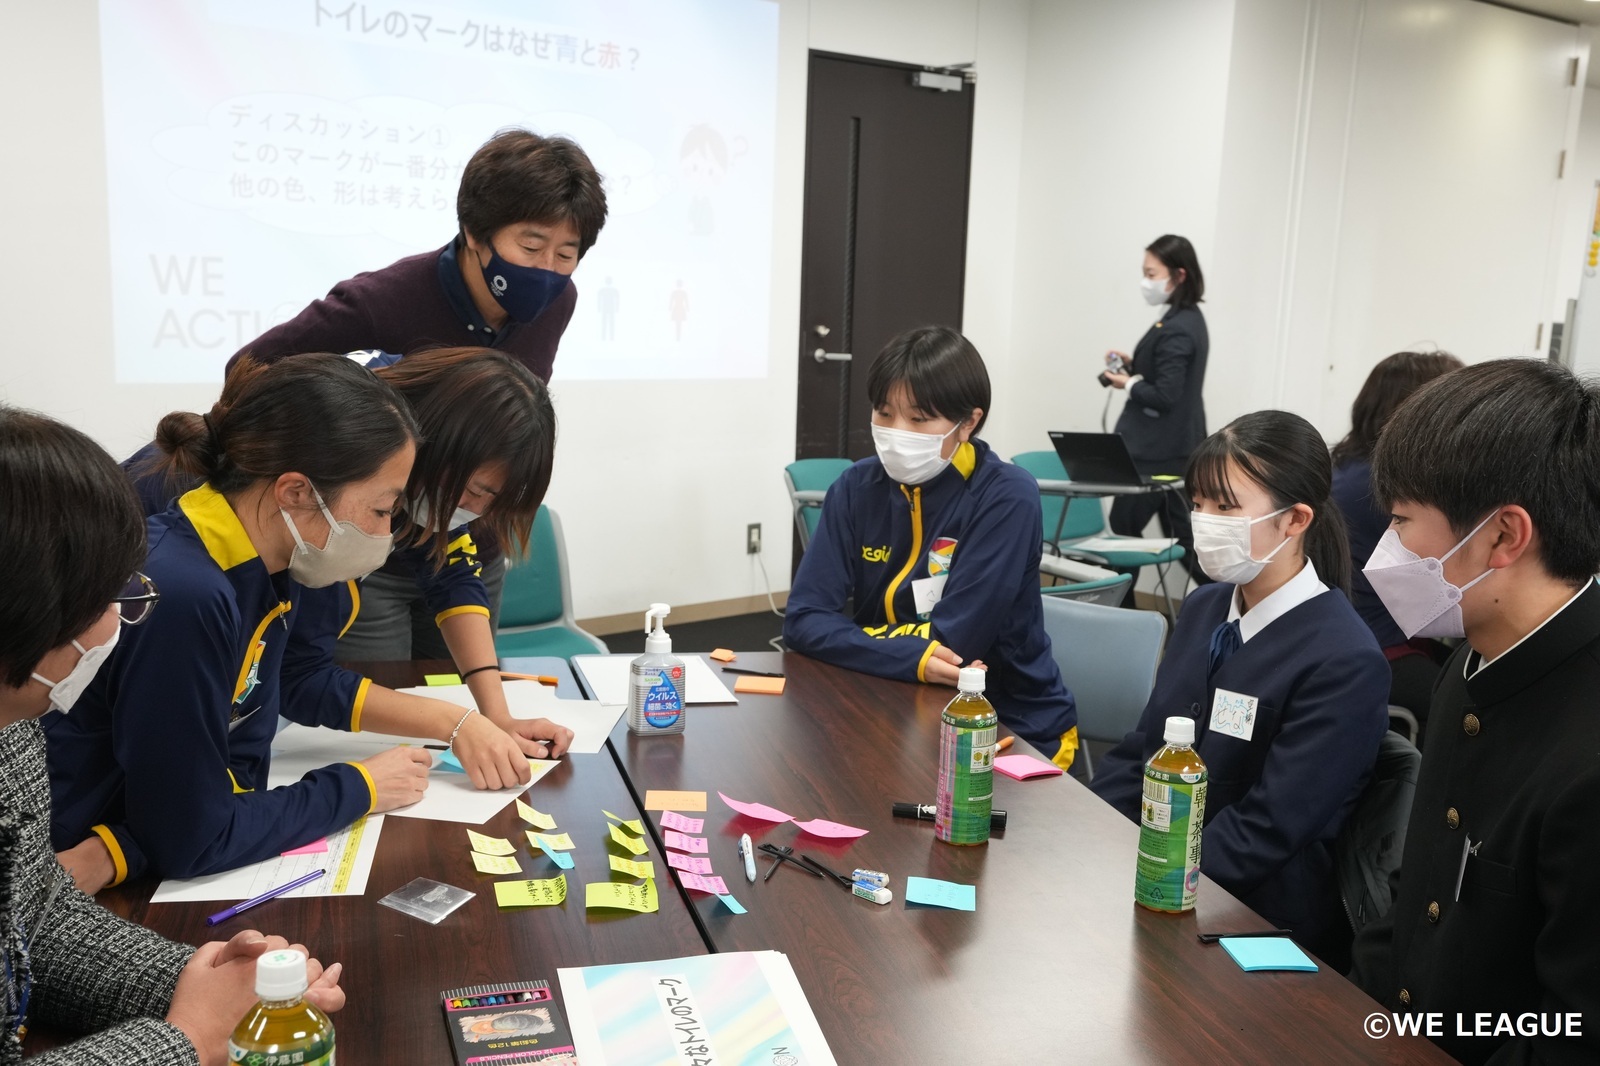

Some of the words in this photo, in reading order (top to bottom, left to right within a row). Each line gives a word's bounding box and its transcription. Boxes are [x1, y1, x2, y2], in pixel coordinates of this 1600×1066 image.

[228, 172, 456, 213] 他の色、形は考えら
[148, 253, 225, 297] WE
[648, 691, 677, 701] ウイルス
[265, 1051, 304, 1066] 伊藤園
[479, 1053, 514, 1062] PENCILS
[515, 1050, 542, 1058] COLOR
